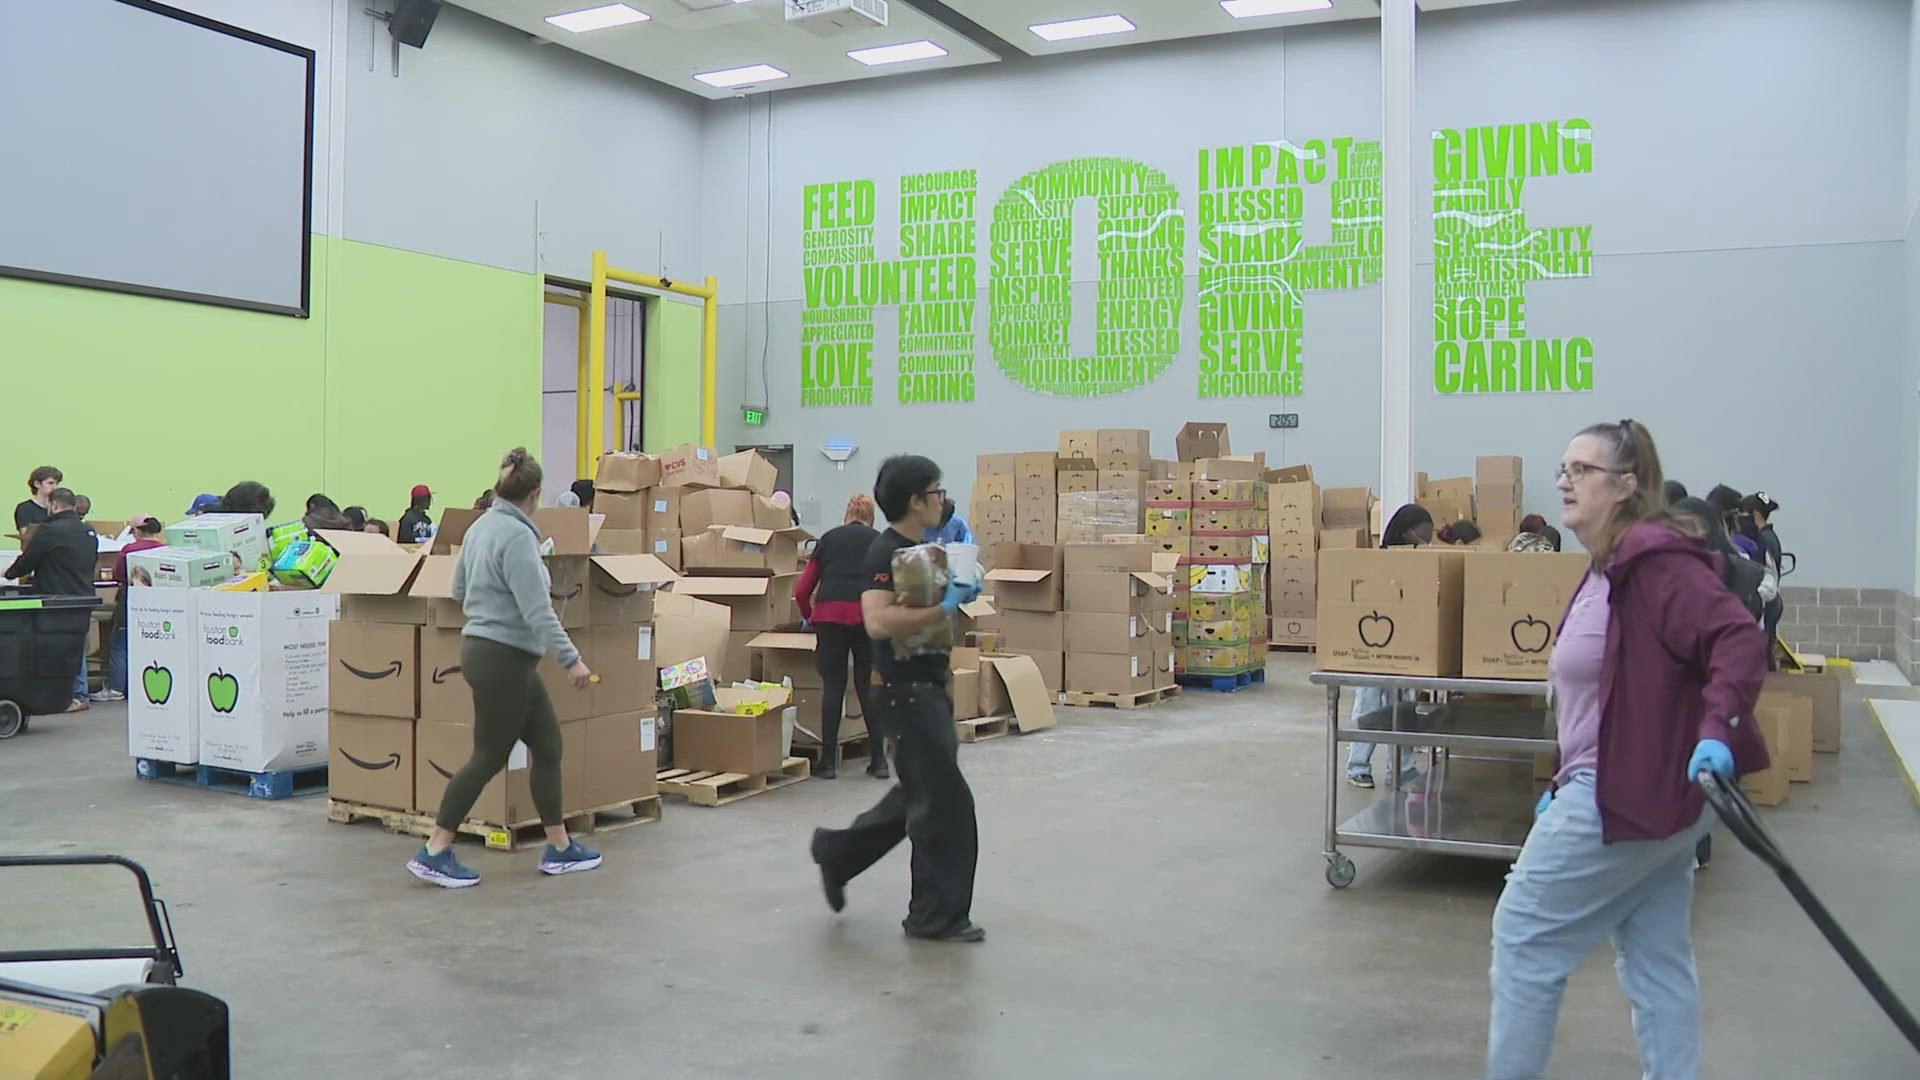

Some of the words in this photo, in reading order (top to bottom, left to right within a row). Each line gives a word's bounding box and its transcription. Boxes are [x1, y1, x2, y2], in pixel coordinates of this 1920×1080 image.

[1199, 137, 1353, 190] IMPACT
[1433, 118, 1592, 183] GIVING
[900, 169, 976, 194] ENCOURAGE
[1021, 166, 1148, 200] COMMUNITY
[1434, 177, 1525, 212] FAMILY
[804, 180, 875, 230] FEED
[900, 190, 976, 224] IMPACT
[993, 198, 1074, 222] GENEROSITY
[1098, 191, 1179, 219] SUPPORT
[1199, 187, 1303, 225] BLESSED
[803, 227, 874, 249] GENEROSITY
[900, 220, 976, 258] SHARE
[990, 217, 1072, 243] OUTREACH
[1098, 215, 1184, 252] GIVING
[1199, 220, 1303, 265] SHARE
[1434, 225, 1592, 258] GENEROSITY
[803, 245, 874, 266] COMPASSION
[990, 238, 1072, 278] SERVE
[1098, 246, 1184, 280] THANKS
[1434, 250, 1592, 282] NOURISHMENT
[803, 256, 976, 308] VOLUNTEER
[990, 274, 1071, 305] INSPIRE
[1098, 276, 1184, 300] VOLUNTEER
[1199, 258, 1361, 292] NOURISHMENT
[1434, 280, 1525, 299] COMMITMENT
[802, 307, 873, 325] NOURISHMENT
[899, 301, 975, 335] FAMILY
[990, 303, 1072, 322] APPRECIATED
[1097, 298, 1183, 330] ENERGY
[1199, 291, 1303, 332] GIVING
[1434, 296, 1526, 341] HOPE
[802, 323, 873, 342] APPRECIATED
[899, 334, 975, 353] COMMITMENT
[989, 319, 1071, 345] CONNECT
[1096, 328, 1180, 357] BLESSED
[802, 342, 873, 388] LOVE
[899, 354, 975, 373] COMMUNITY
[992, 343, 1071, 361] COMMITMENT
[1199, 330, 1303, 374] SERVE
[1434, 336, 1593, 394] CARING
[1019, 355, 1156, 384] NOURISHMENT
[1198, 371, 1303, 397] ENCOURAGE
[801, 387, 873, 406] PRODUCTIVE
[898, 372, 975, 404] CARING
[746, 411, 762, 425] EXIT
